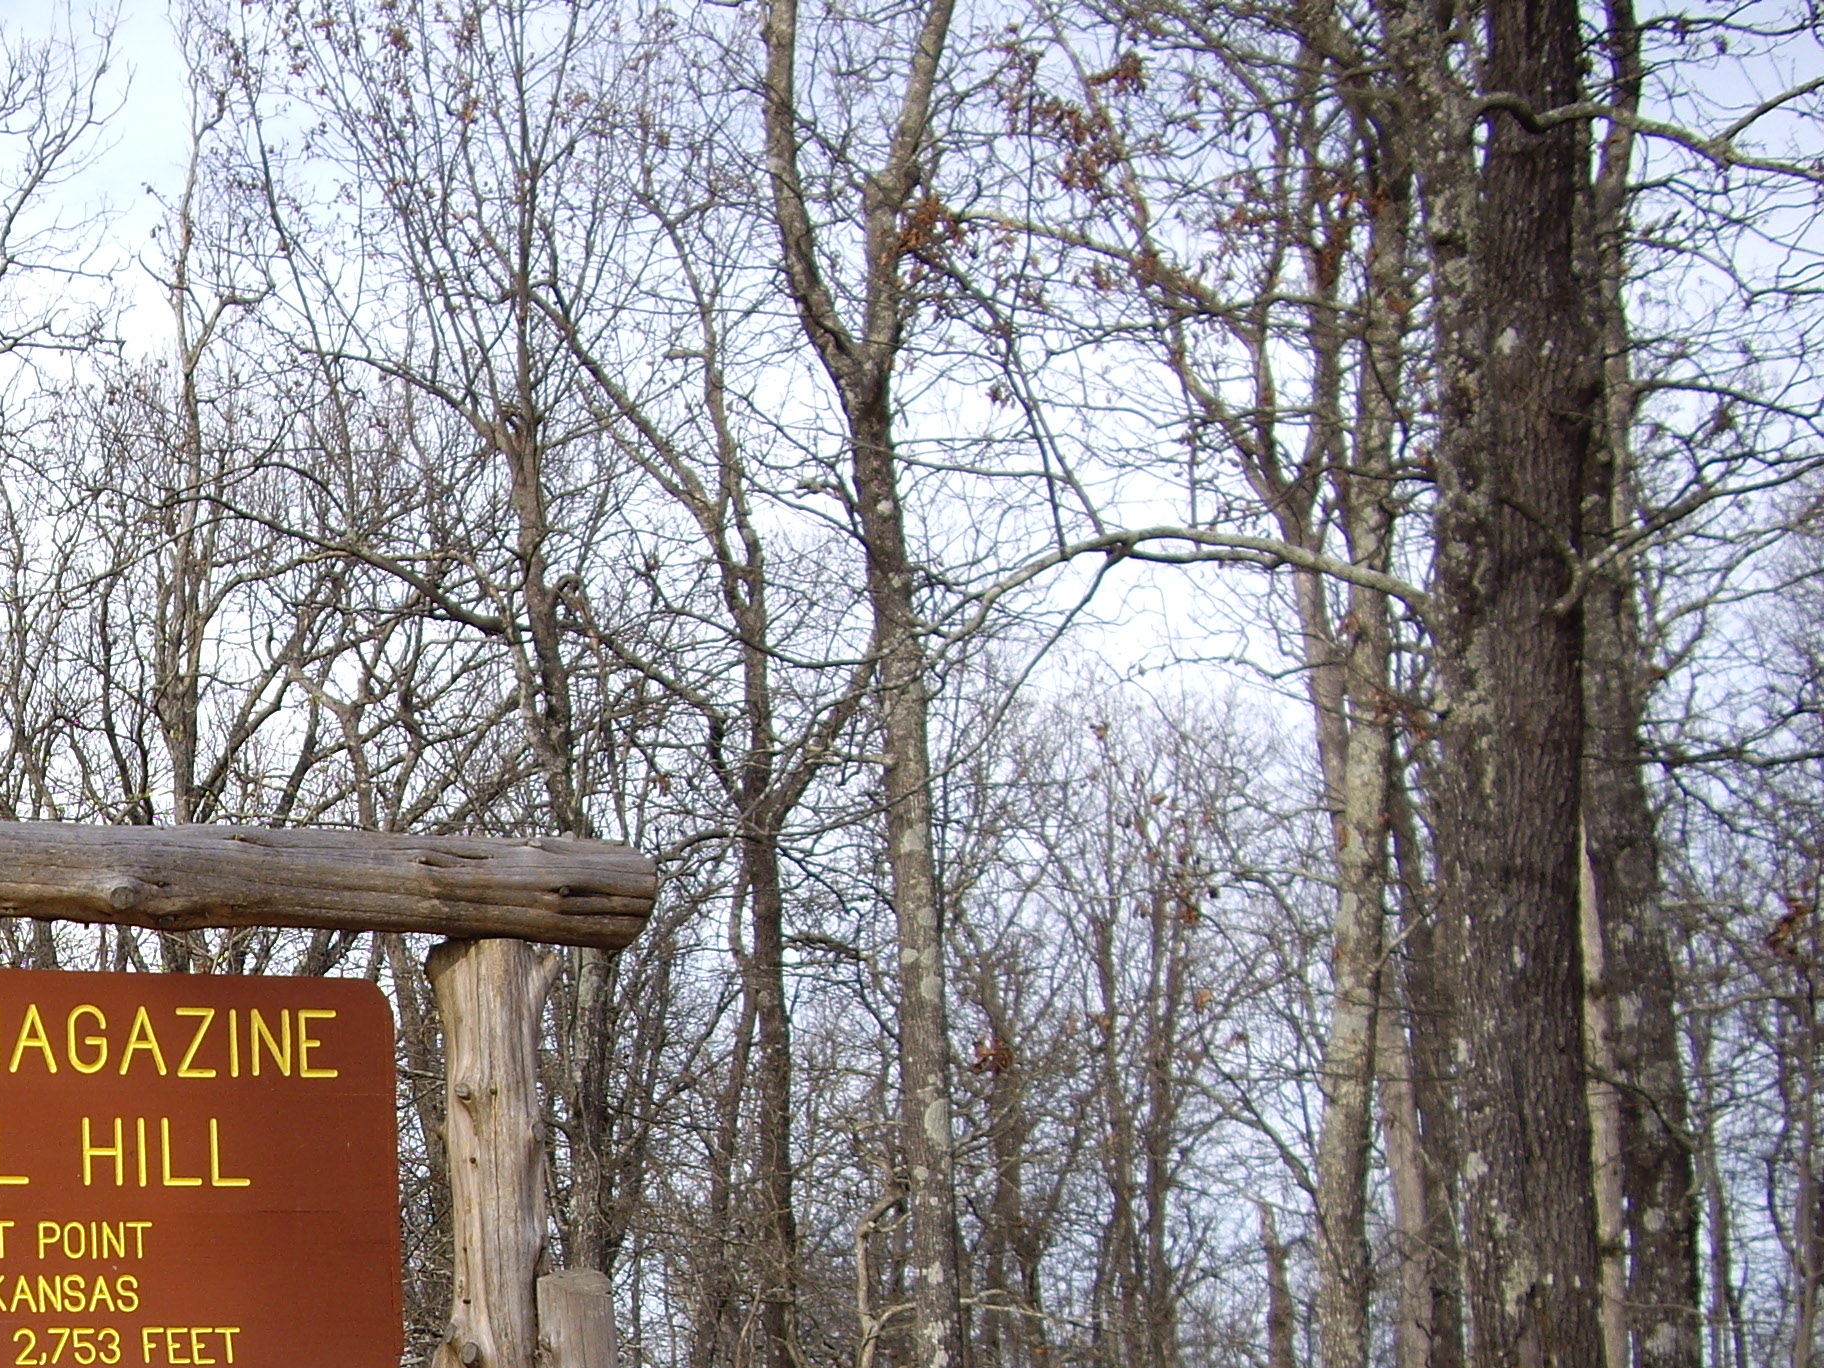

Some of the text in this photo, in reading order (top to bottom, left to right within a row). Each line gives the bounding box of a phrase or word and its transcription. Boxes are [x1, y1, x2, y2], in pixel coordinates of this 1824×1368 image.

[81, 1116, 252, 1188] HILL
[37, 1220, 153, 1260] POINT
[12, 1327, 121, 1367] 2,753
[141, 1326, 241, 1366] FEET
